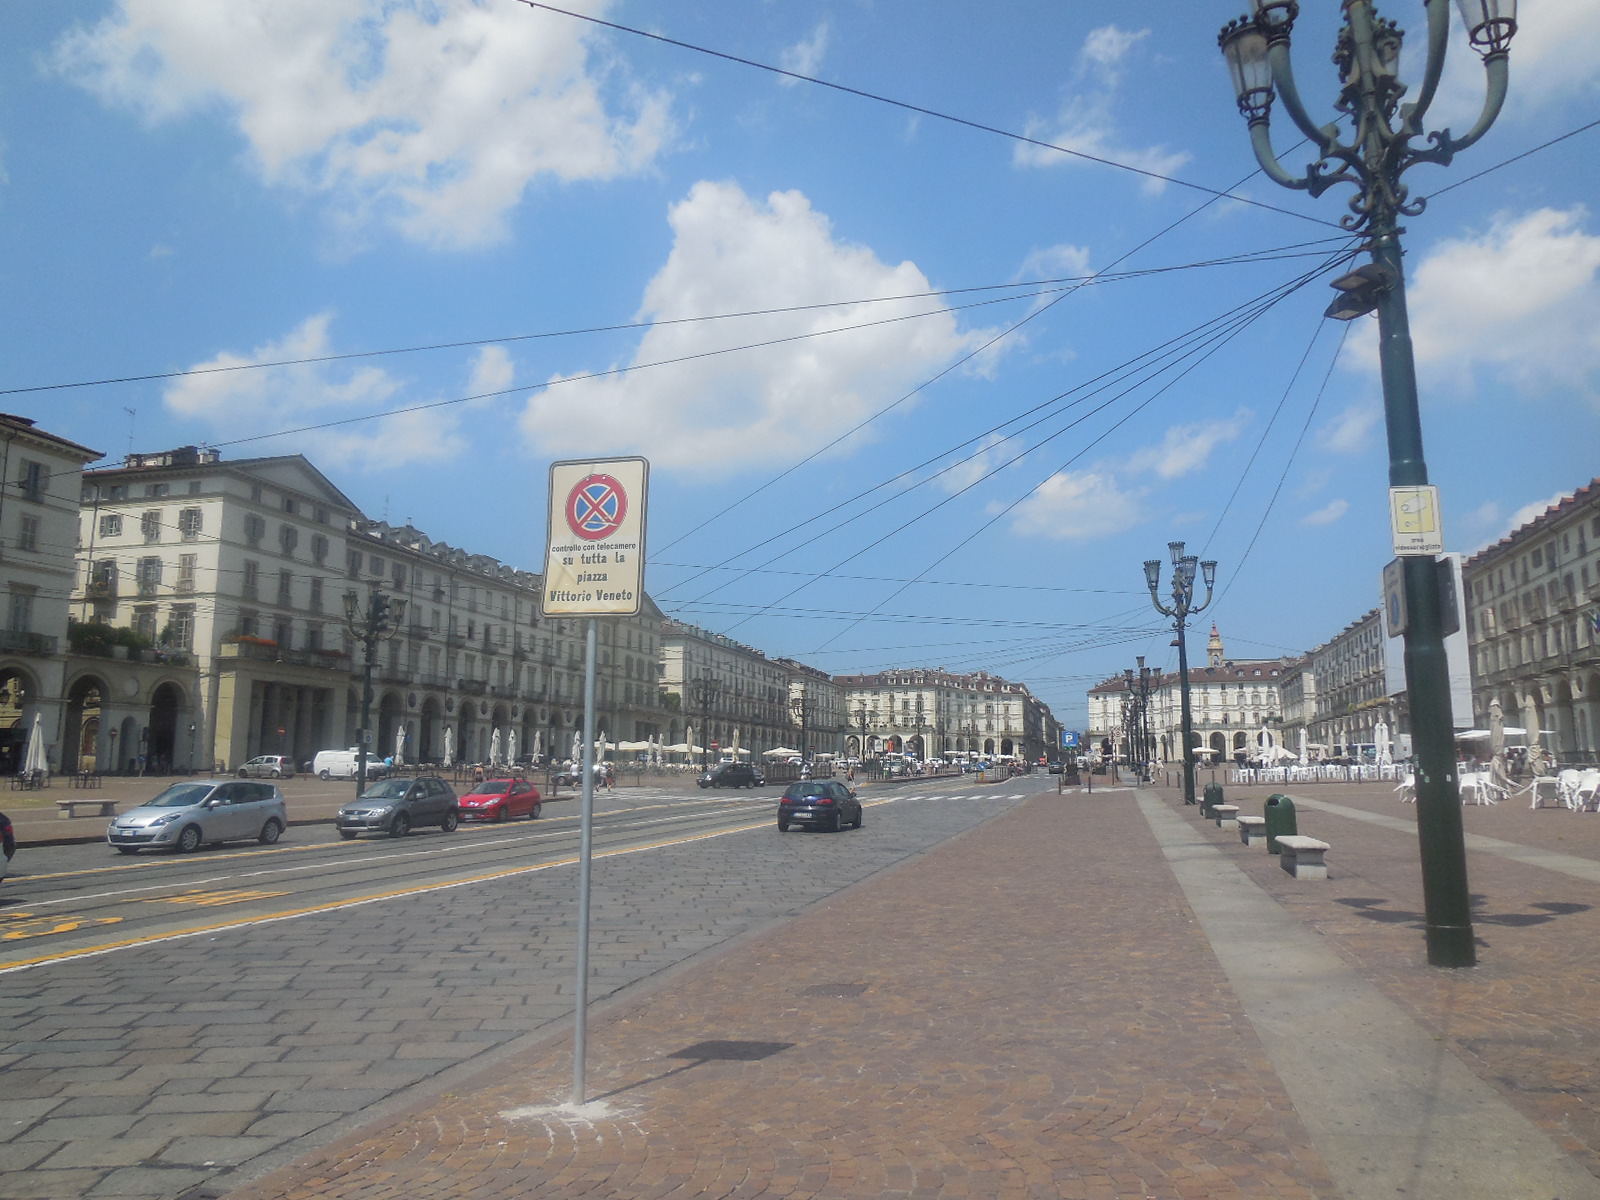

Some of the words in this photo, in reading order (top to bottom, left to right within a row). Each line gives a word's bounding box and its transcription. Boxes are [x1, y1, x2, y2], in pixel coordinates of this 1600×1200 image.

[551, 544, 581, 552] controllo
[562, 556, 574, 565] su
[581, 553, 607, 564] tutta
[615, 551, 625, 563] la
[577, 571, 608, 585] piazza
[550, 590, 592, 602] Vittorio
[596, 588, 632, 600] Veneto
